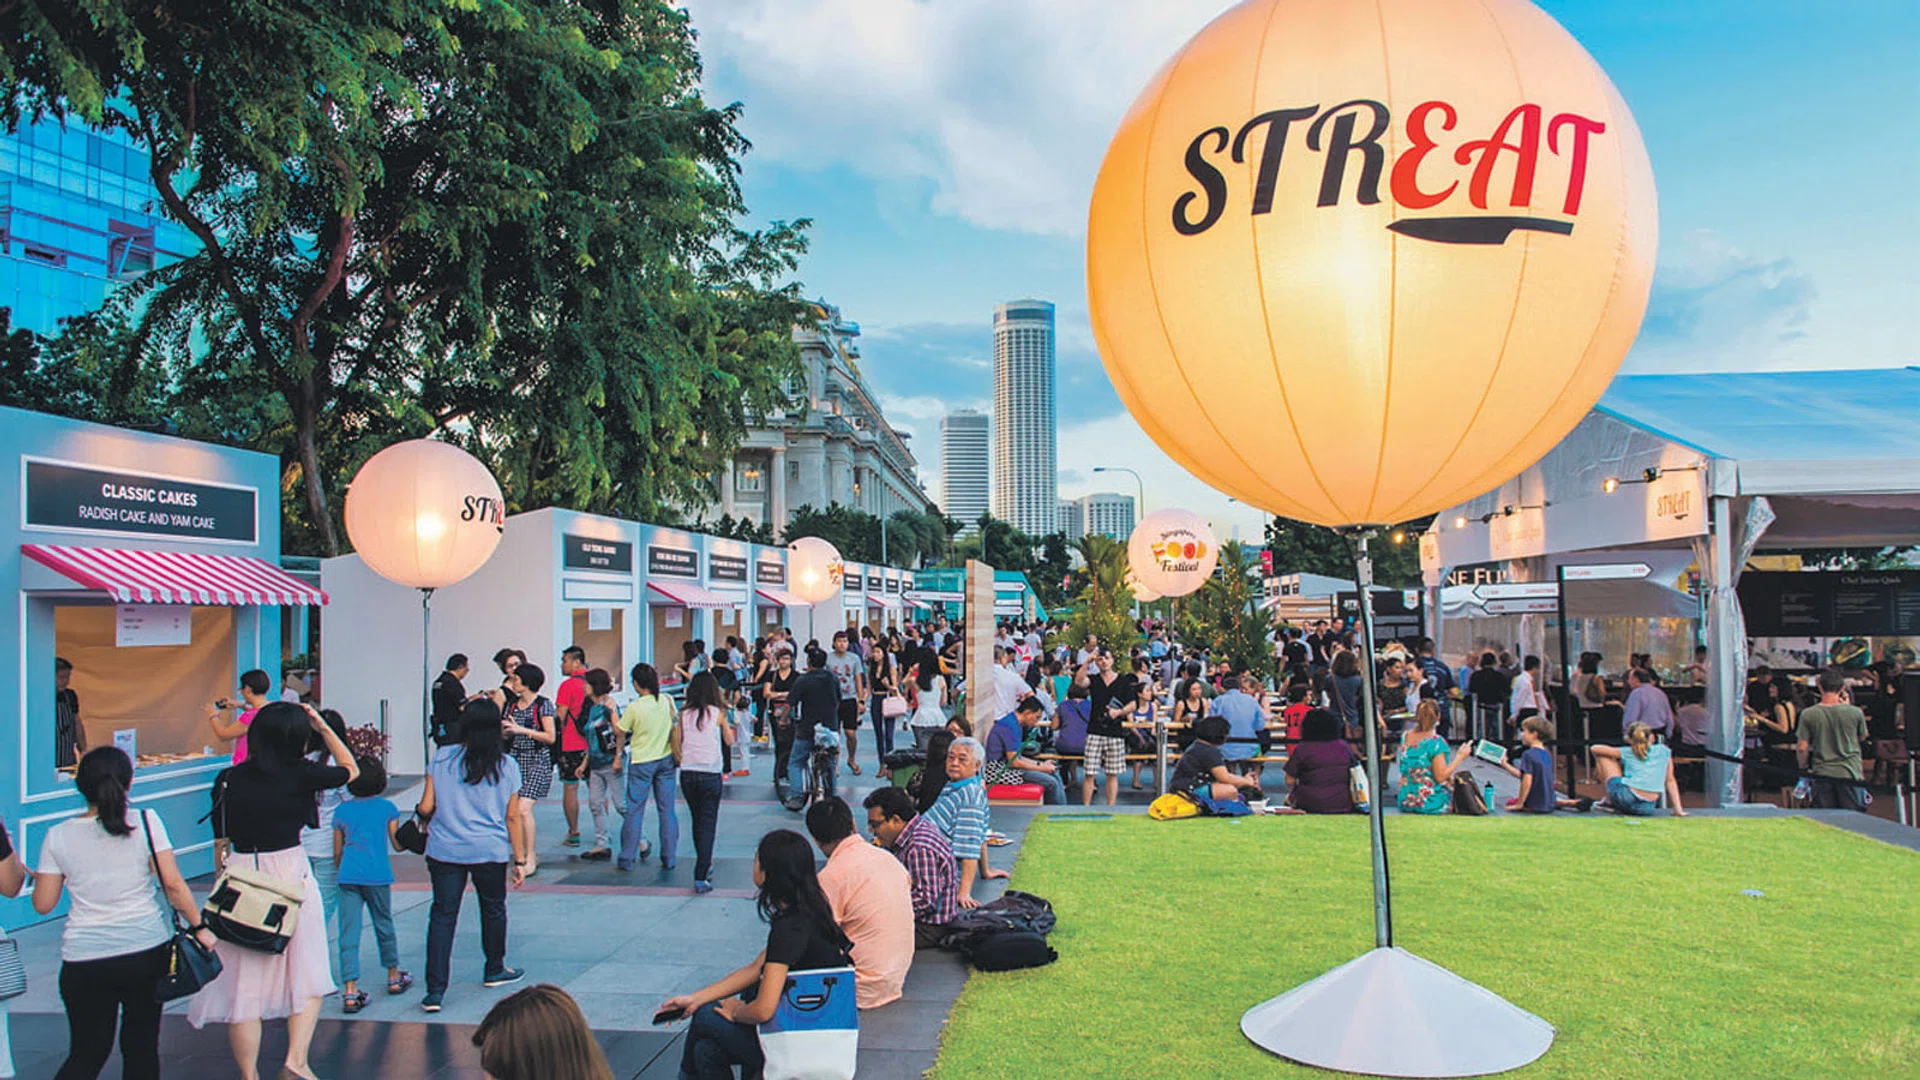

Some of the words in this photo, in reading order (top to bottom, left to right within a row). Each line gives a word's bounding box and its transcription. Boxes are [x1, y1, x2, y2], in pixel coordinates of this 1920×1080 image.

[1171, 99, 1606, 236] STREAT
[101, 483, 156, 503] CLASSIC
[157, 489, 199, 507] CAKES
[78, 504, 119, 521] RADISH
[119, 508, 147, 524] CAKE
[148, 512, 170, 526] AND
[169, 513, 192, 528] YAM
[191, 515, 217, 530] CAKE
[1160, 560, 1199, 572] Festival
